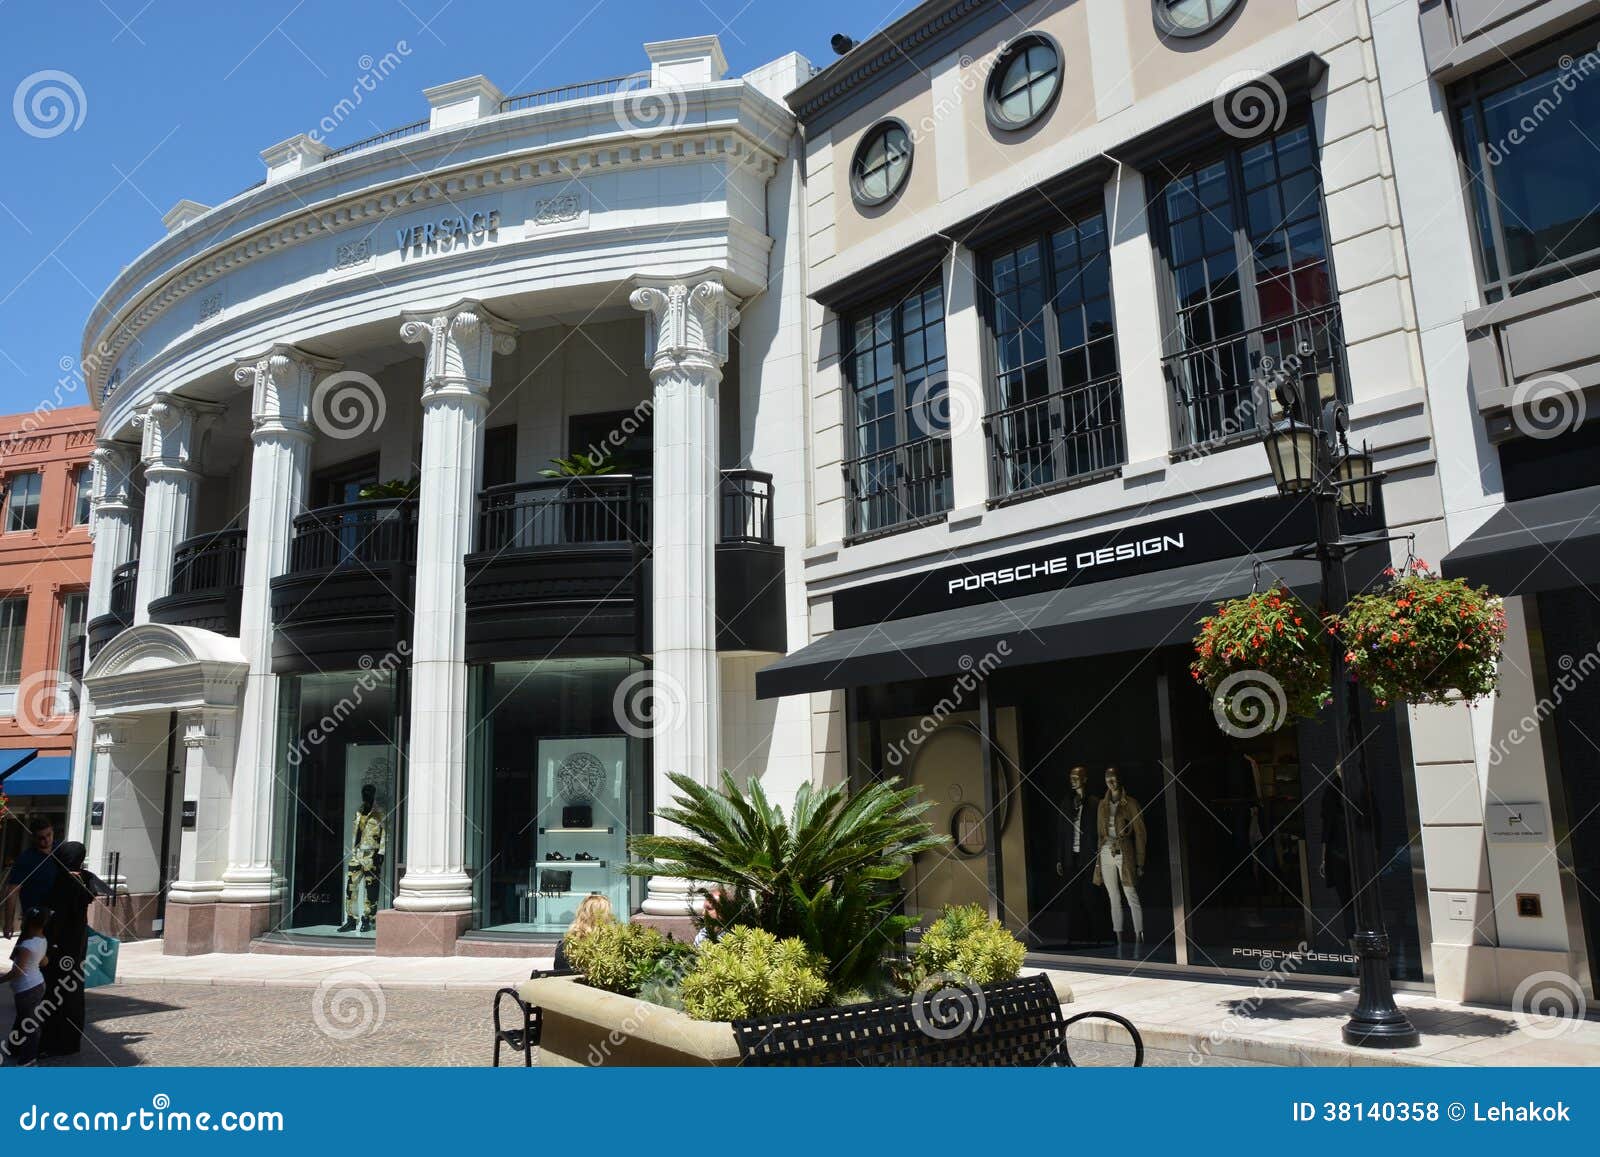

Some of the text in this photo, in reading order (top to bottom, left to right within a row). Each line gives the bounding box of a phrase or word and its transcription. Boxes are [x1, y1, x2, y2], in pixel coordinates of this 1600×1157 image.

[396, 209, 501, 250] VERSACE
[948, 532, 1185, 595] PORSCHE DESIGN
[1232, 947, 1303, 961] PORSCHE
